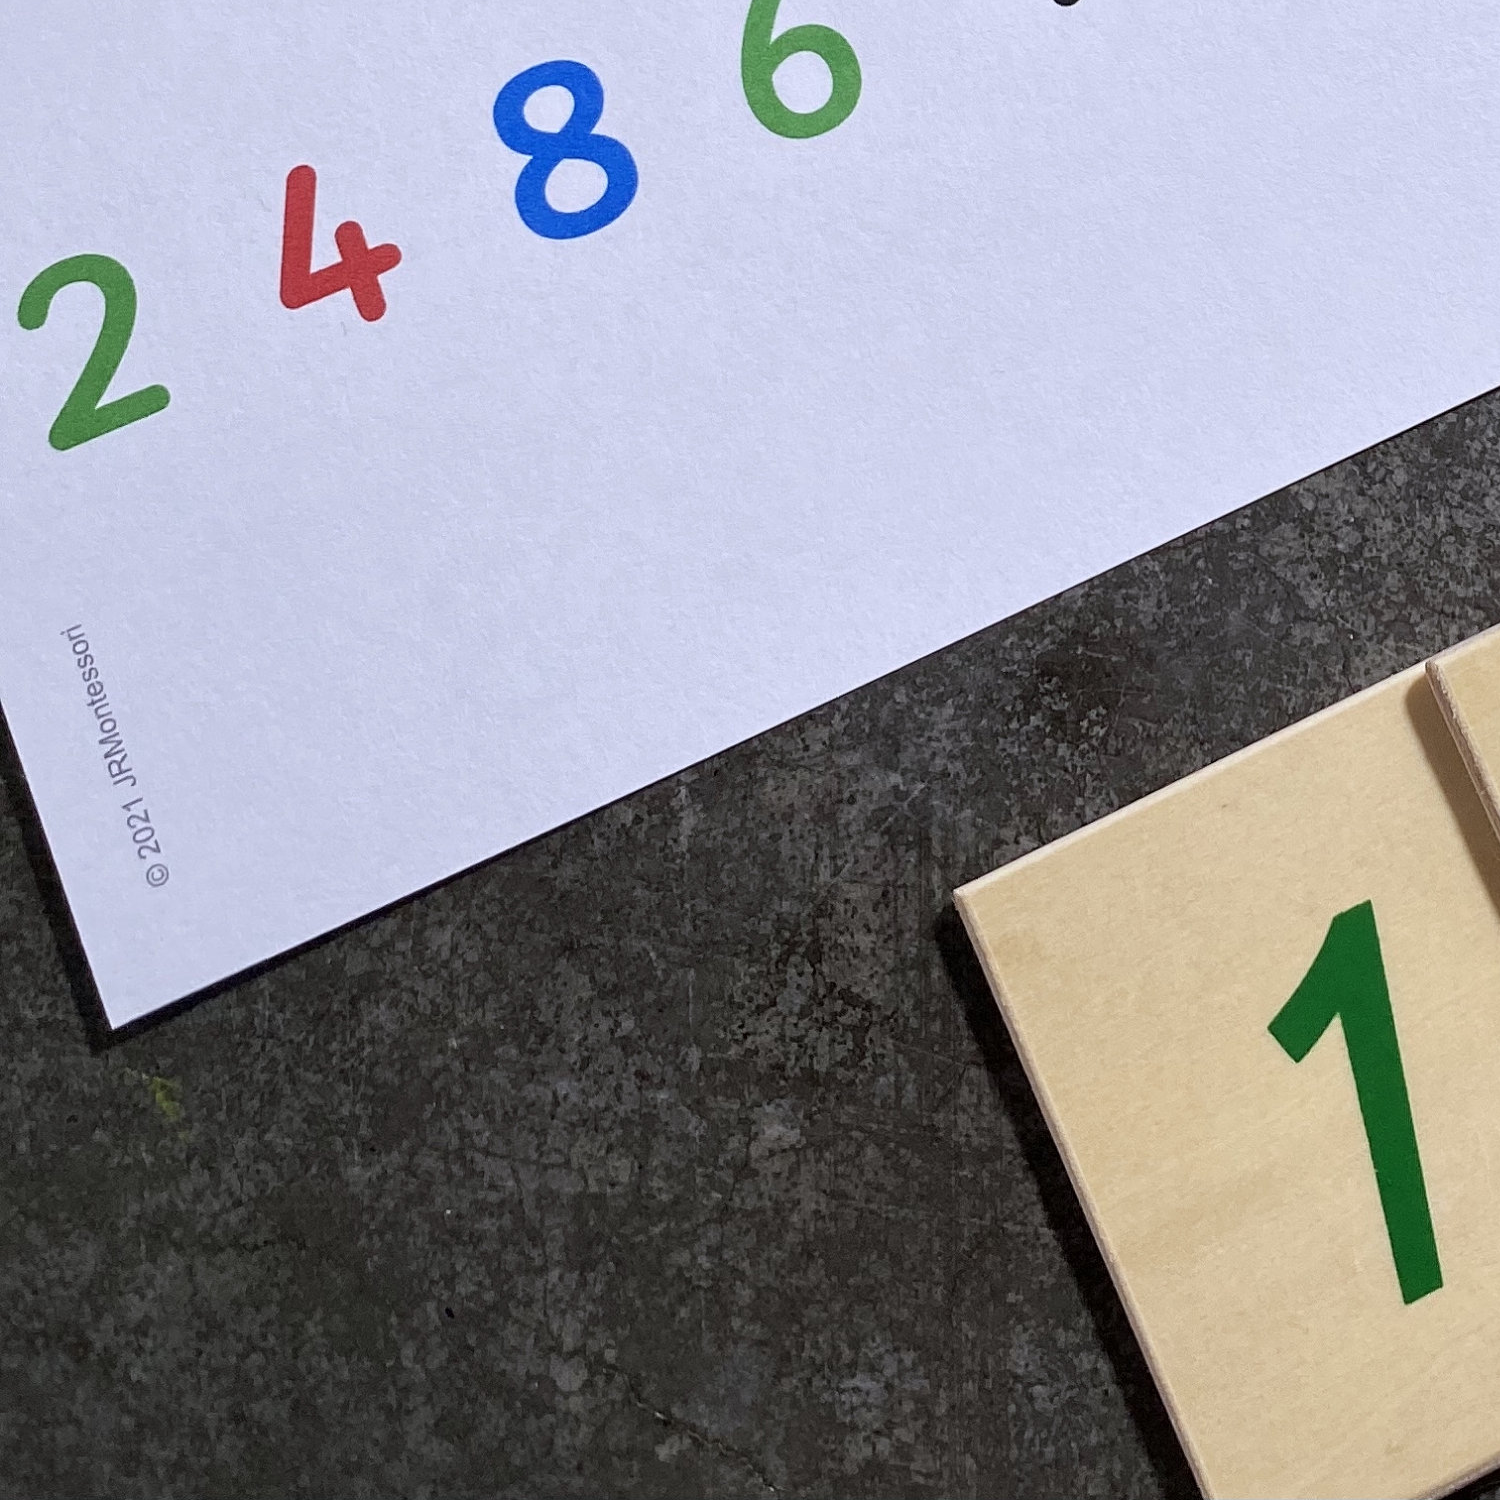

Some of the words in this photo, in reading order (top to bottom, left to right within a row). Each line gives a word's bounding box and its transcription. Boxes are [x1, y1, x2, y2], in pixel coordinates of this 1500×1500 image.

[17, 254, 170, 453] 2
[279, 165, 402, 323] 4
[492, 58, 640, 242] 8
[60, 623, 138, 788] JRMontessori
[121, 796, 161, 859] 2021
[1267, 900, 1444, 1305] 1
